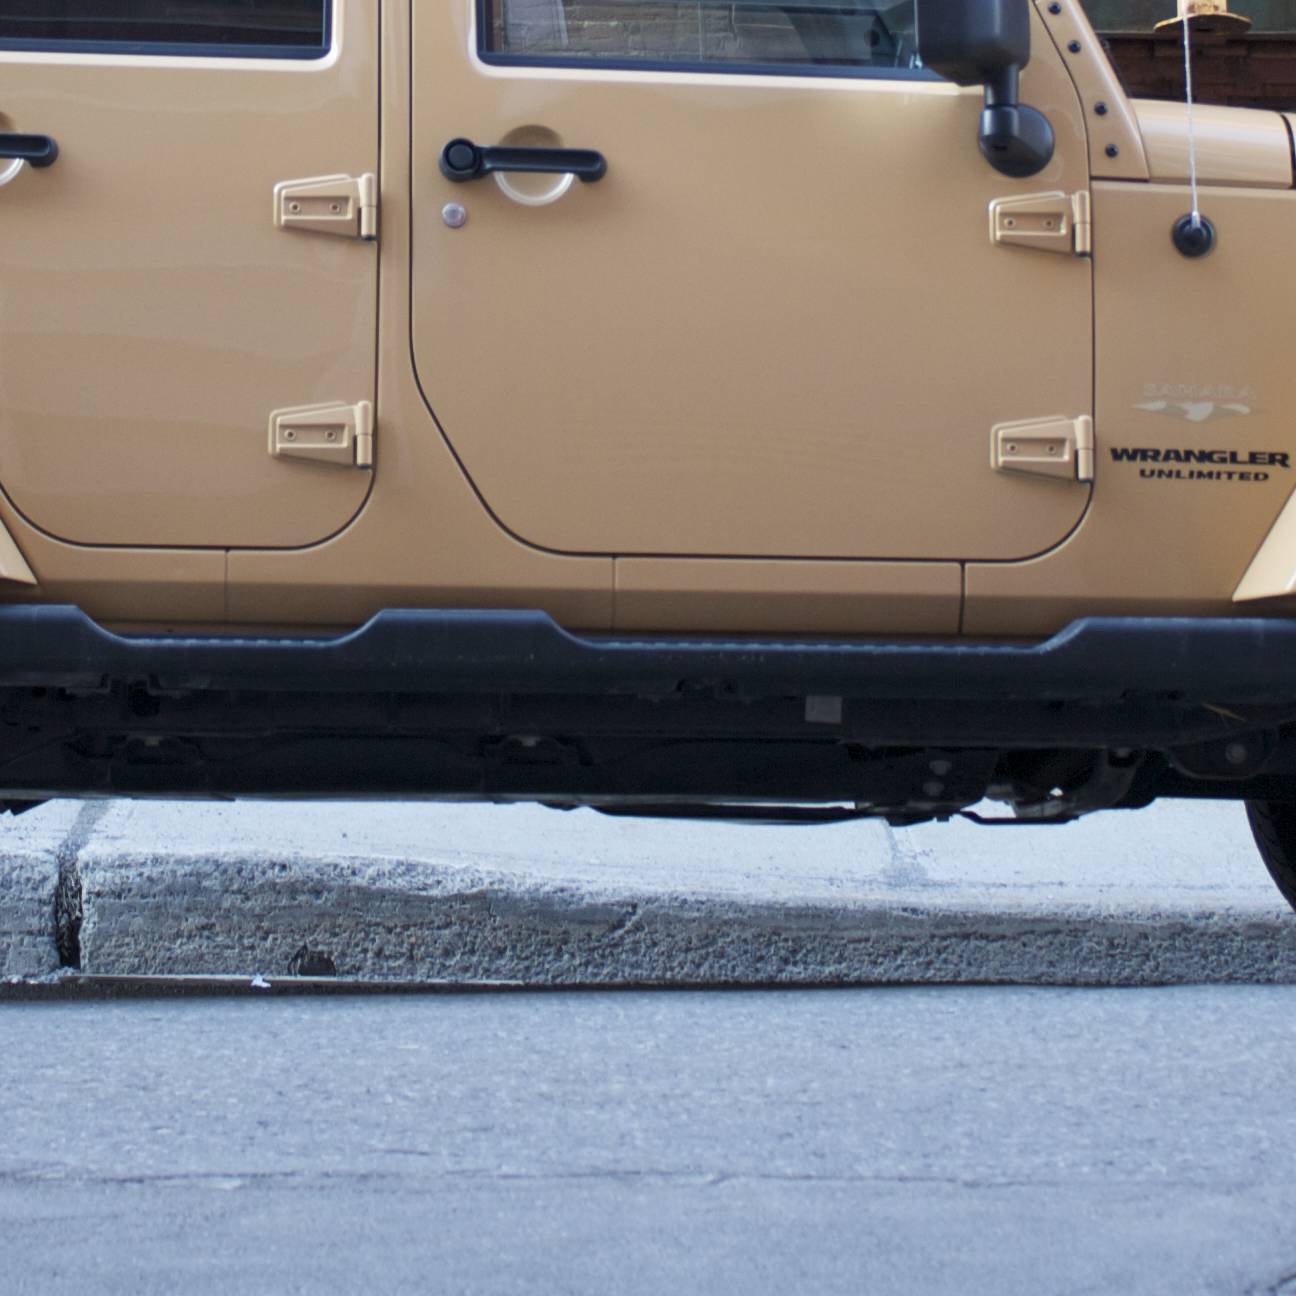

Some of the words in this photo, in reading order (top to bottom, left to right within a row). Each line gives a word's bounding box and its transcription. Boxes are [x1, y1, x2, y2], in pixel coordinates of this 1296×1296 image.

[1144, 384, 1253, 398] SAHARA
[1110, 447, 1291, 468] WRANGLER
[1139, 469, 1269, 482] UNLIMITED
